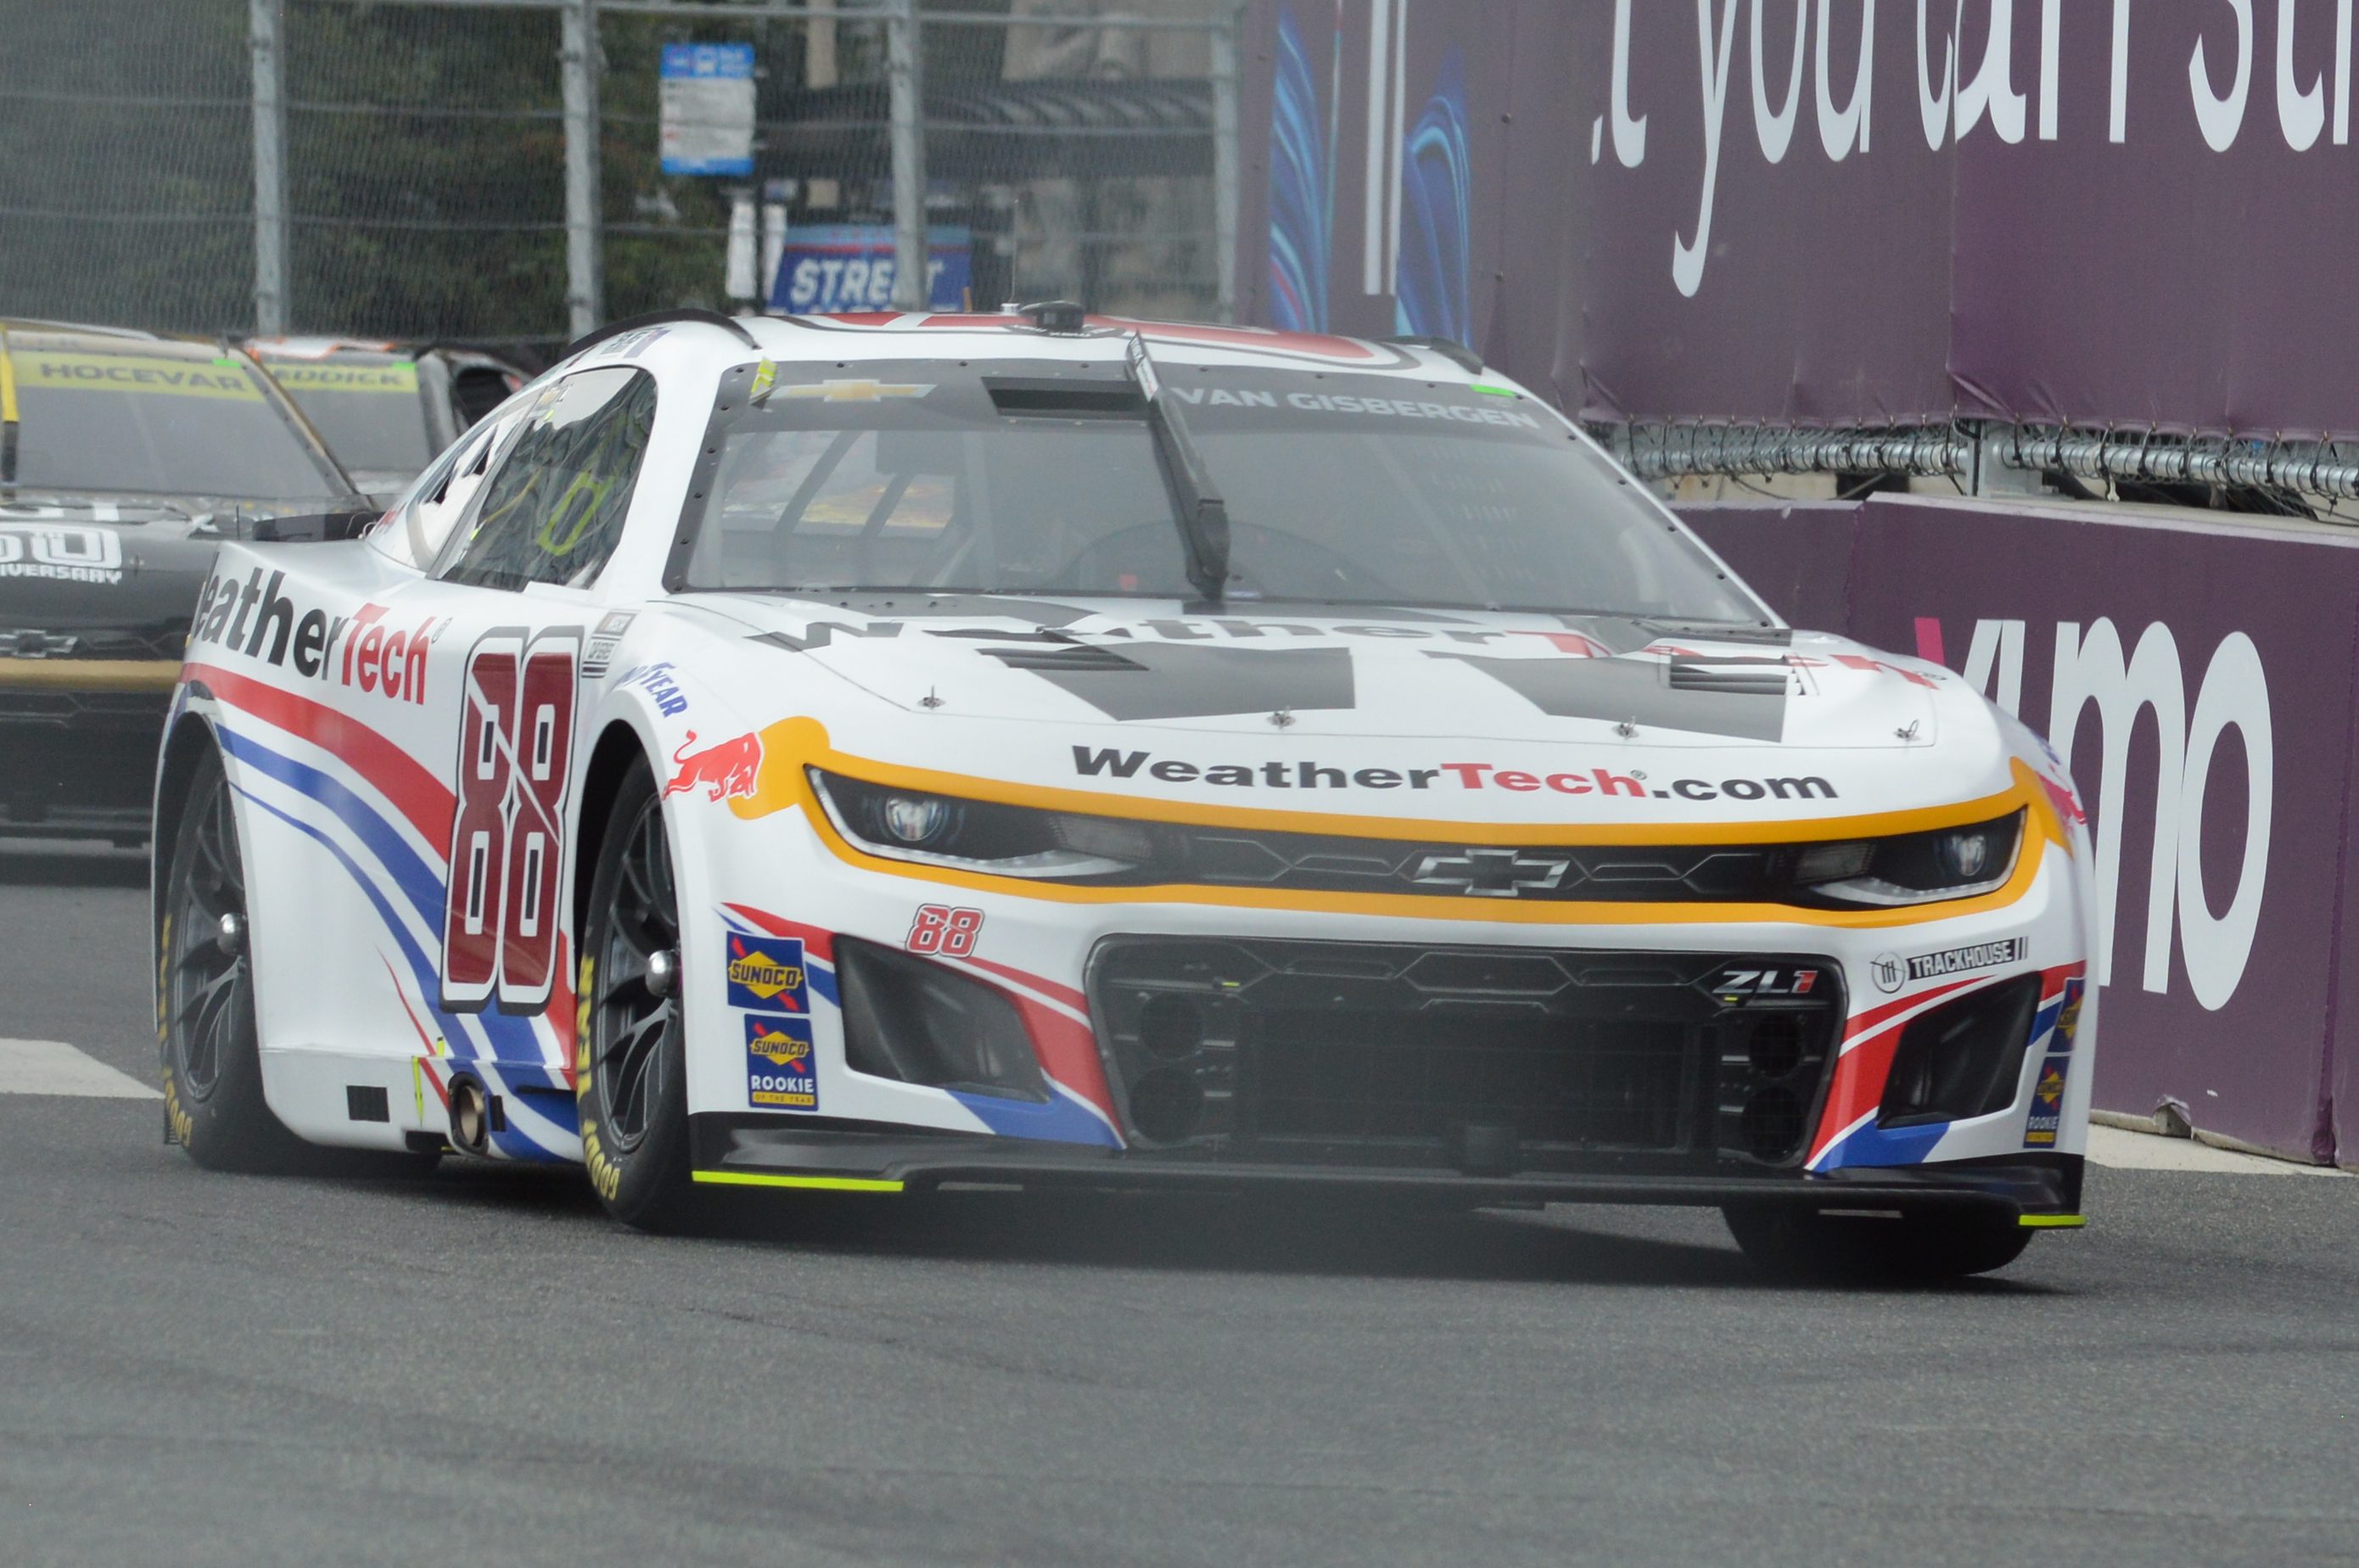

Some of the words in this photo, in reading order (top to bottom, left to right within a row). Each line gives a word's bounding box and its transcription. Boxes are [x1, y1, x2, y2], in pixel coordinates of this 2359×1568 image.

[789, 258, 944, 305] STRET
[40, 363, 246, 393] HOCEVAR
[273, 367, 401, 385] EDDICK
[1170, 387, 1278, 408] VAN
[1287, 392, 1542, 429] GISBERGEN
[193, 566, 436, 705] eatherTech
[440, 625, 585, 1016] 88
[905, 903, 985, 958] 88
[1911, 940, 2012, 978] TRACKHOUSE
[731, 962, 798, 987] SUNOCO
[1712, 970, 1818, 994] ZL1
[754, 1039, 806, 1056] SUNOCO
[751, 1074, 815, 1093] ROOKIE
[2027, 1116, 2059, 1129] ROOKIE
